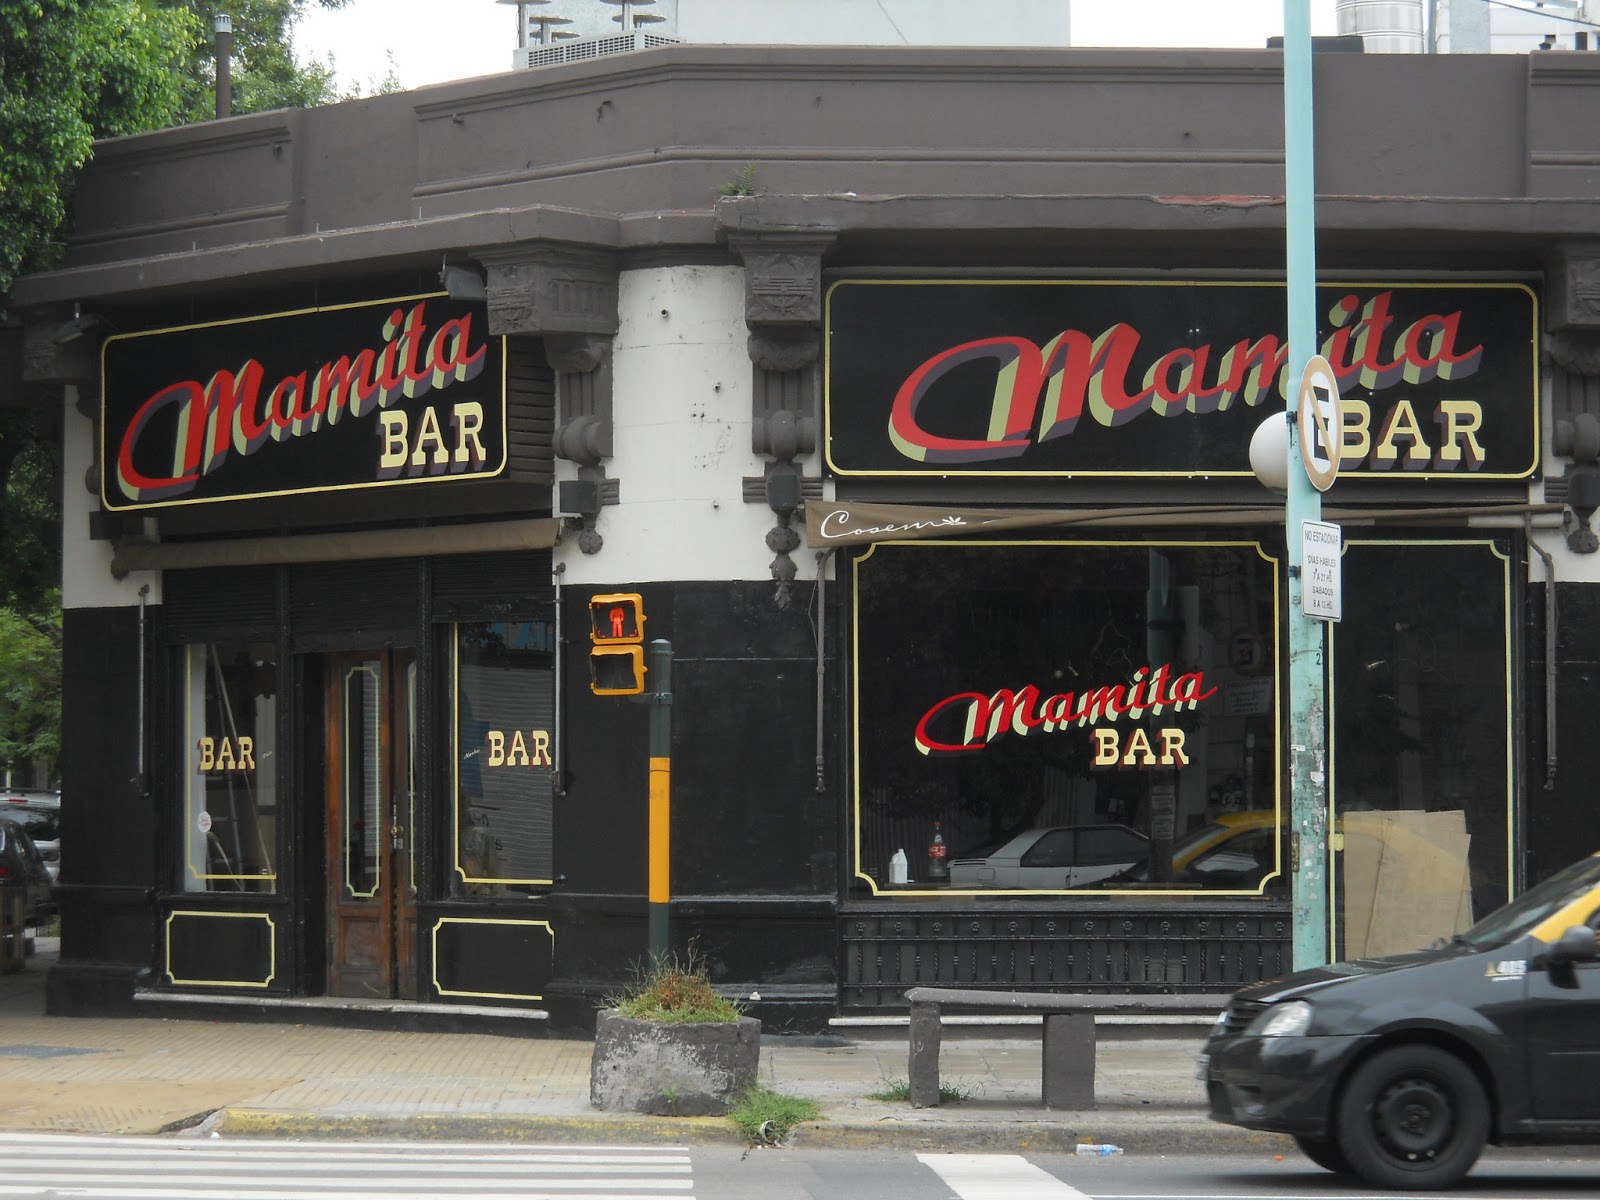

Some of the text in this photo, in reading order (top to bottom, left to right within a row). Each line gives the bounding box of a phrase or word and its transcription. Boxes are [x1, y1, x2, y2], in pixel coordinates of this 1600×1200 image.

[117, 301, 487, 500] Mamita
[889, 291, 1484, 464] Mamita
[379, 401, 487, 468] BAR
[1339, 399, 1486, 463] BAR
[1304, 529, 1312, 541] NO
[1312, 585, 1334, 597] SABADOS
[914, 663, 1218, 756] Mamita
[199, 736, 256, 771] BAR
[488, 730, 552, 767] BAR
[1094, 727, 1190, 766] BAR
